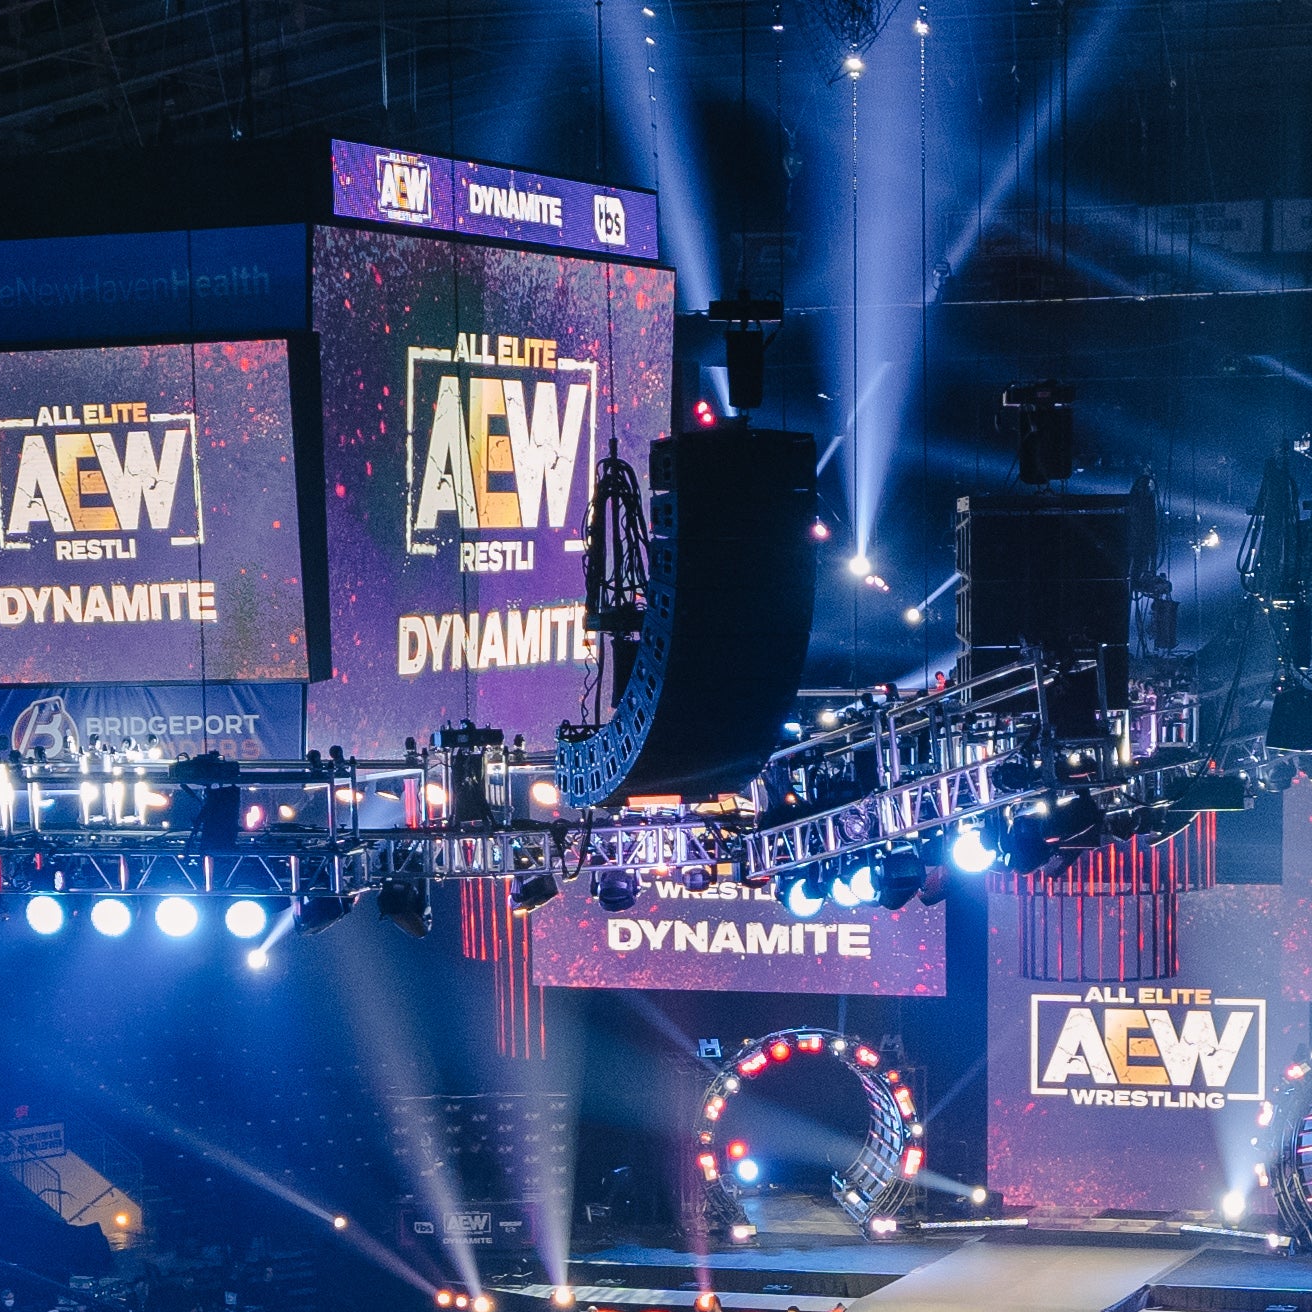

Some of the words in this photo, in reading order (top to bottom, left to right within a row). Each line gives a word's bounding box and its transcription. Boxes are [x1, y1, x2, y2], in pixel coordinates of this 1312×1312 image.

[380, 163, 427, 211] AEW
[469, 183, 563, 227] DYNAMITE
[458, 334, 496, 364] ALL
[497, 336, 557, 370] ELITE
[37, 404, 80, 426] ALL
[83, 403, 148, 424] ELITE
[421, 375, 590, 530] AEW
[7, 430, 187, 533] AEW
[56, 538, 137, 561] RESTLI
[458, 541, 535, 573] RESTLI
[398, 603, 598, 677] DYNAMITE
[86, 715, 260, 736] BRIDGEPORT
[607, 918, 871, 958] DYNAMITE
[1085, 987, 1134, 1005] ALL
[1138, 987, 1212, 1005] ELITE
[1043, 1008, 1254, 1087] AEW
[1071, 1087, 1226, 1110] WRESTLING
[447, 1216, 487, 1231] AEW
